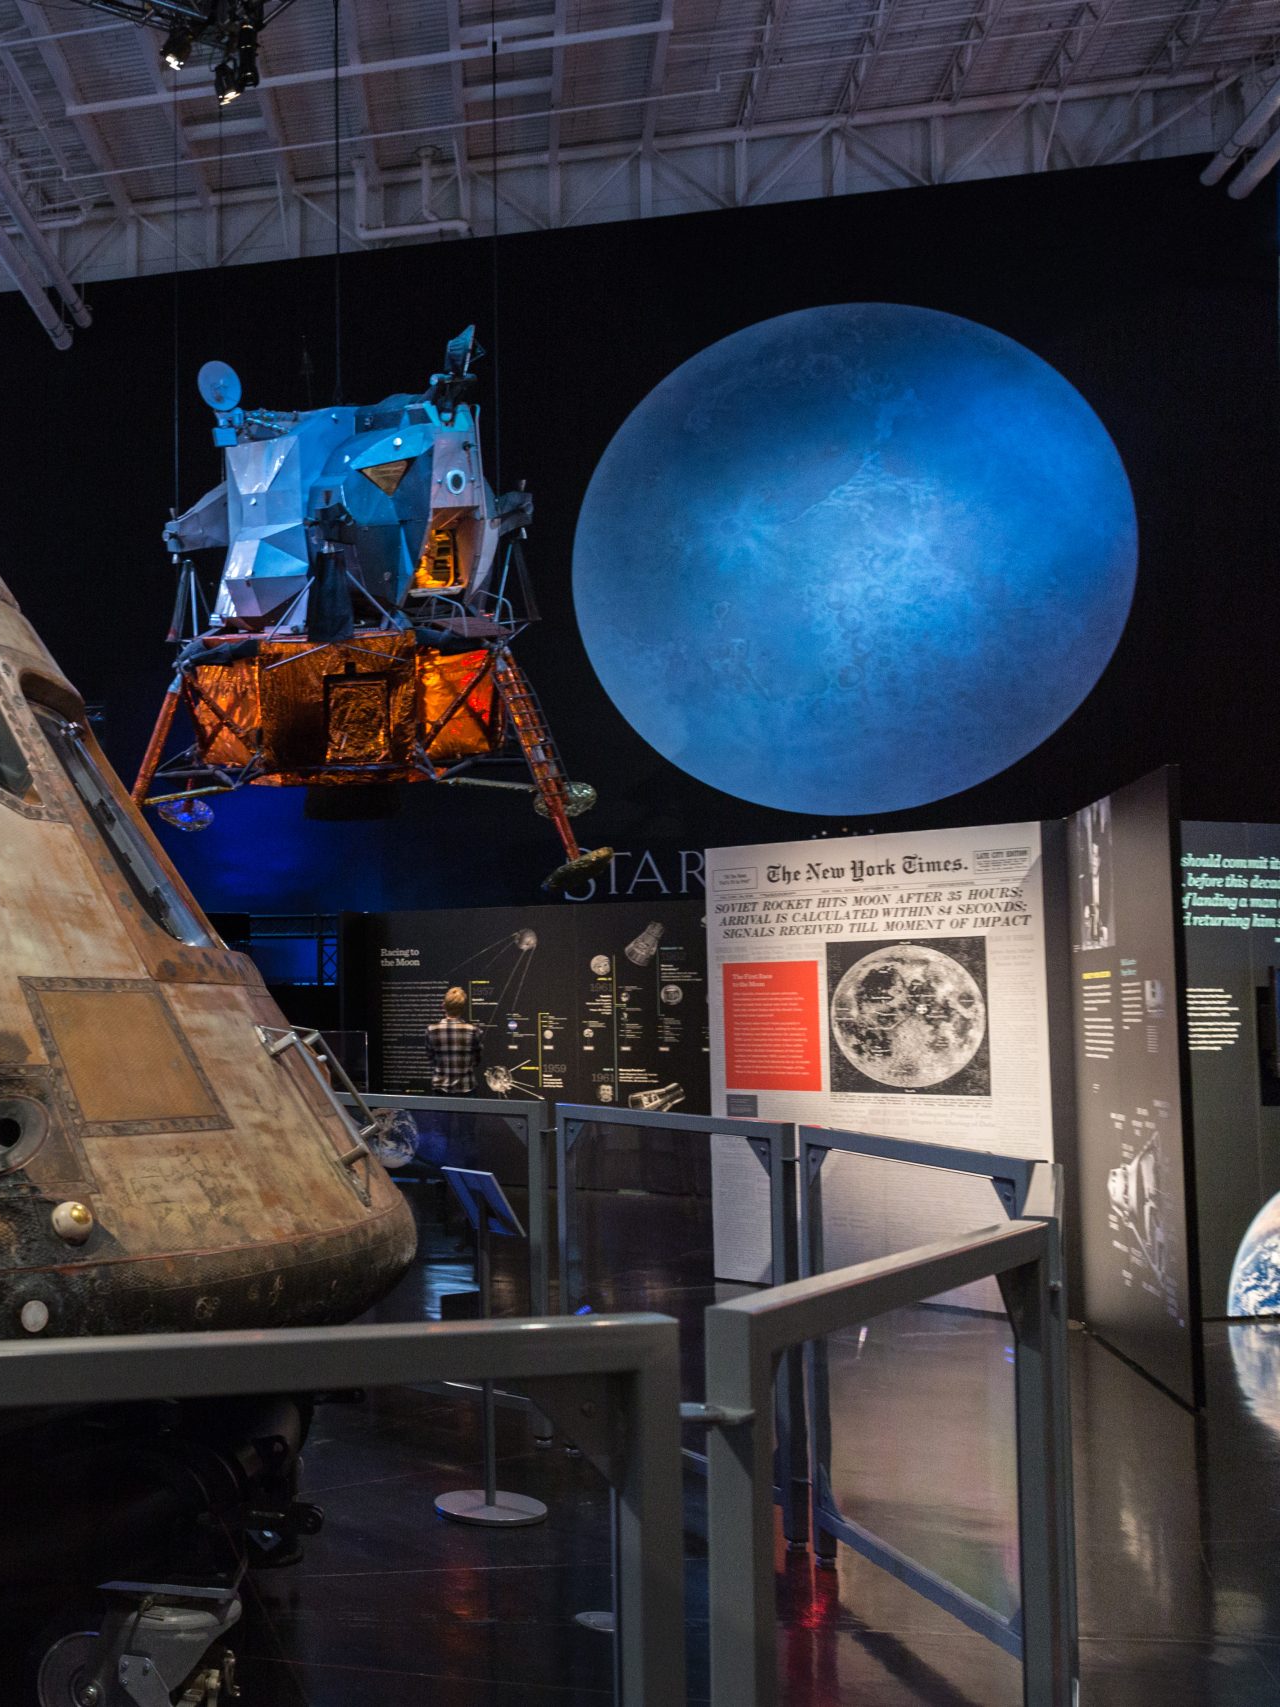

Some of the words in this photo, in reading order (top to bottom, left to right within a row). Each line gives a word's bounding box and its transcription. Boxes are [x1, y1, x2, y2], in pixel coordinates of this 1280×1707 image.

[766, 863, 801, 885] The
[806, 862, 845, 883] New
[850, 858, 896, 882] York
[902, 853, 969, 874] Times.
[1181, 853, 1222, 868] should
[1222, 856, 1268, 869] commit
[1187, 872, 1224, 890] before
[1225, 874, 1249, 888] this
[715, 902, 759, 914] SOVIET
[762, 899, 813, 912] ROCKET
[817, 896, 848, 909] HITS
[851, 893, 892, 906] MOON
[895, 891, 943, 905] AFTER
[946, 891, 963, 901] 35
[1192, 892, 1238, 910] landing
[1239, 897, 1249, 907] a
[1249, 898, 1277, 908] man
[719, 913, 771, 926] ARRIVAL
[775, 913, 789, 923] IS
[792, 908, 879, 923] CALCULATED
[883, 905, 933, 918] WITHIN
[937, 905, 952, 915] 84
[1192, 914, 1251, 929] returning
[1251, 913, 1276, 927] him
[722, 926, 775, 939] SIGNALS
[779, 924, 844, 936] RECEIVED
[848, 922, 879, 933] TILL
[883, 919, 945, 932] MOMENT
[949, 918, 970, 929] OF
[973, 914, 1032, 929] IMPACT
[380, 948, 410, 958] Racing
[410, 948, 420, 957] to
[380, 958, 395, 967] the
[395, 958, 421, 967] Moon
[543, 1063, 567, 1073] 1959
[591, 1073, 614, 1083] 1961
